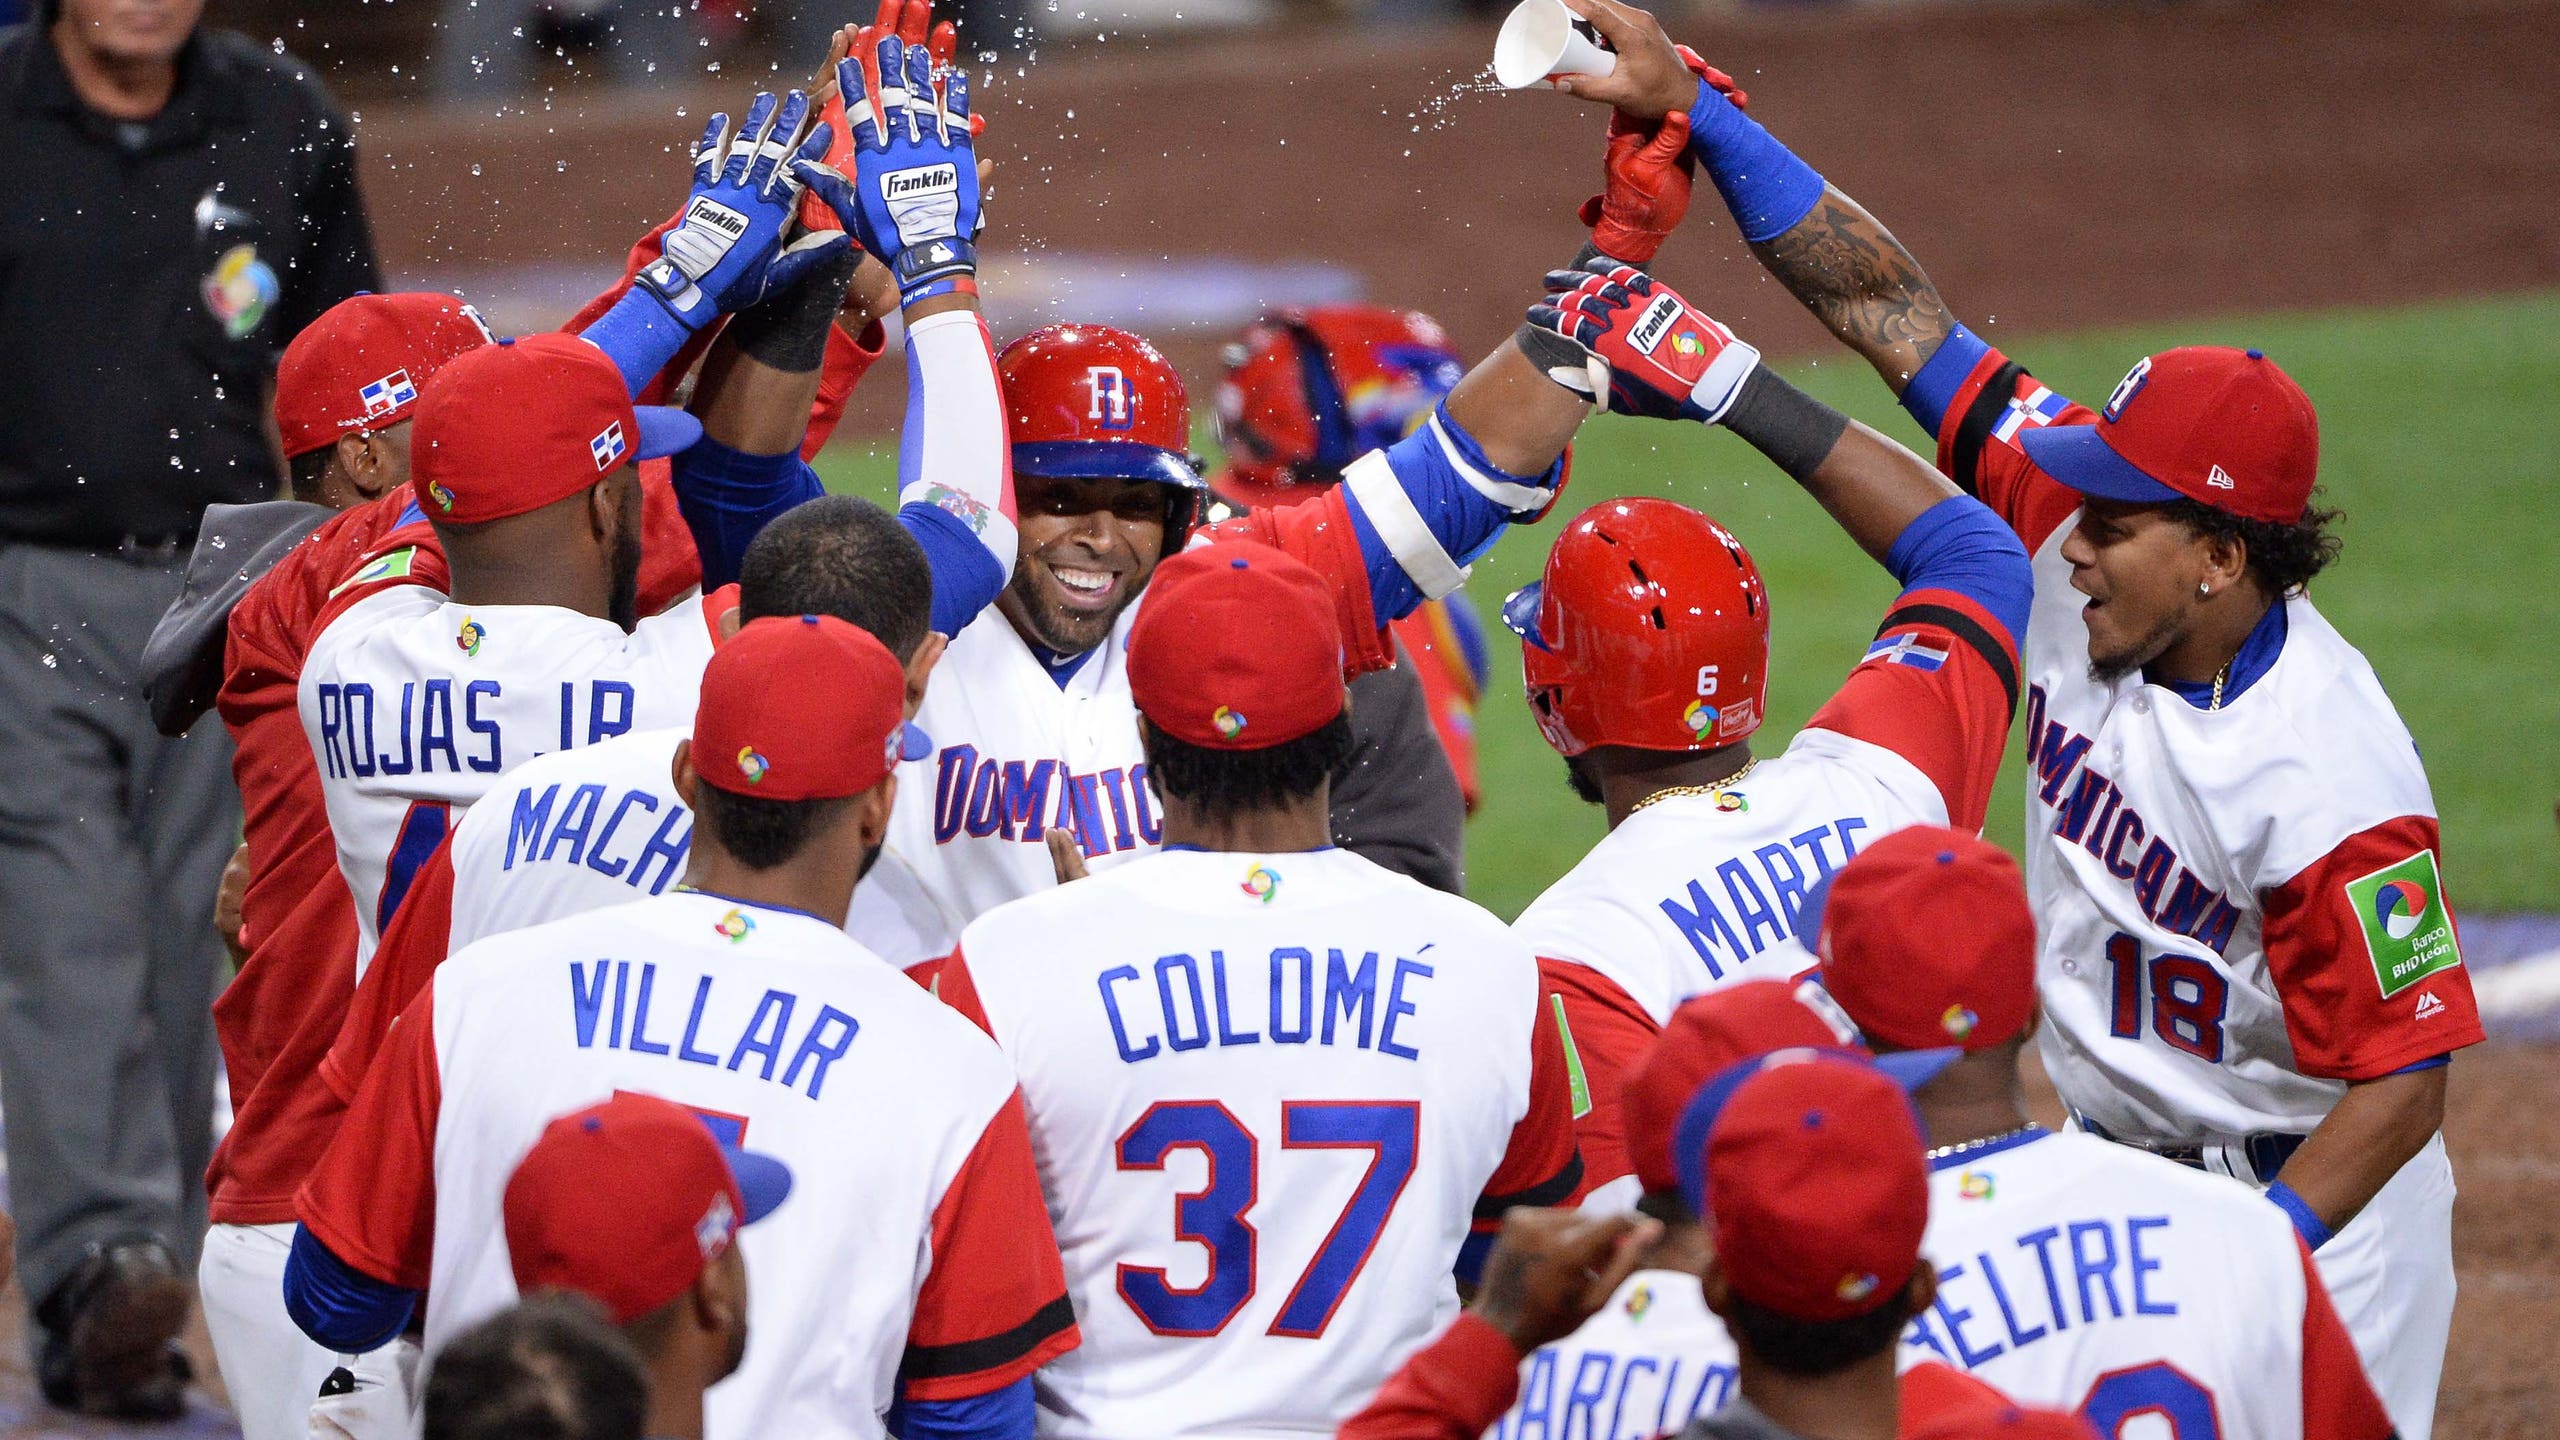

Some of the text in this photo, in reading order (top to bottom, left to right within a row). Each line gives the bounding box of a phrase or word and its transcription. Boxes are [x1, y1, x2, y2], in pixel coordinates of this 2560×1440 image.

[687, 199, 744, 235] Franklin
[318, 679, 502, 778] ROJAS
[1697, 665, 1719, 696] 6
[2391, 942, 2451, 980] BHD León
[2411, 926, 2446, 952] Banco
[570, 959, 860, 1101] VILLAR
[1098, 944, 1436, 1064] COLOMÉ
[2105, 930, 2229, 1064] 18
[1115, 1099, 1421, 1340] 37
